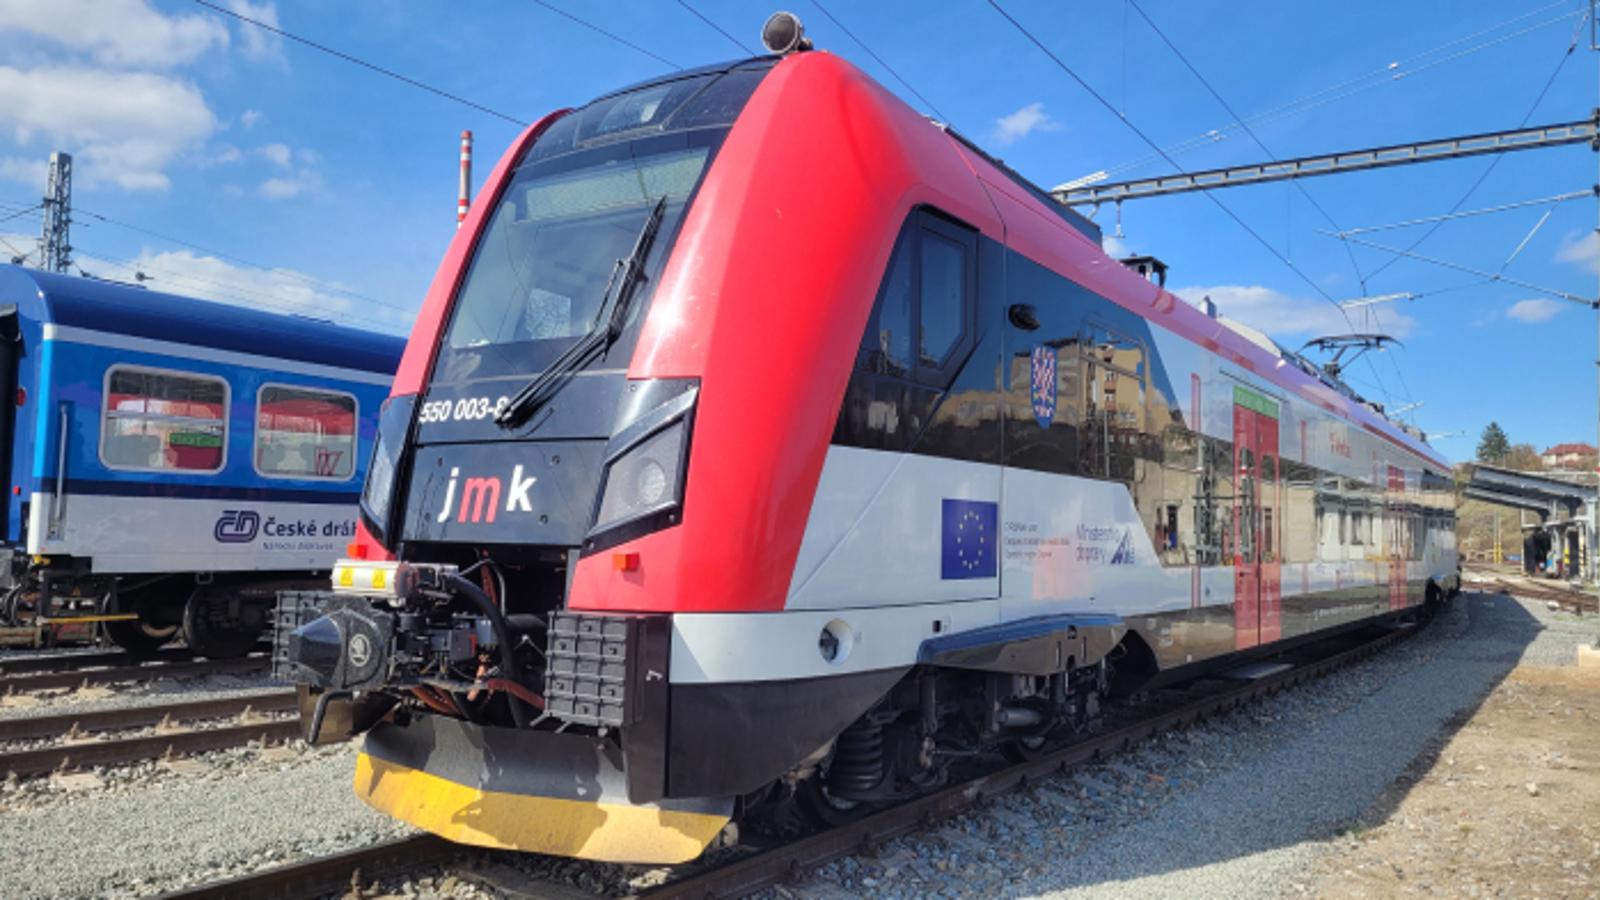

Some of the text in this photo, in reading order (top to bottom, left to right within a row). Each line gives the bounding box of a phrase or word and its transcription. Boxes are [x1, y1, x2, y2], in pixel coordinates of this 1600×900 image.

[419, 400, 452, 423] 550
[437, 464, 537, 523] jmk
[263, 516, 317, 537] České
[321, 519, 357, 537] dráh
